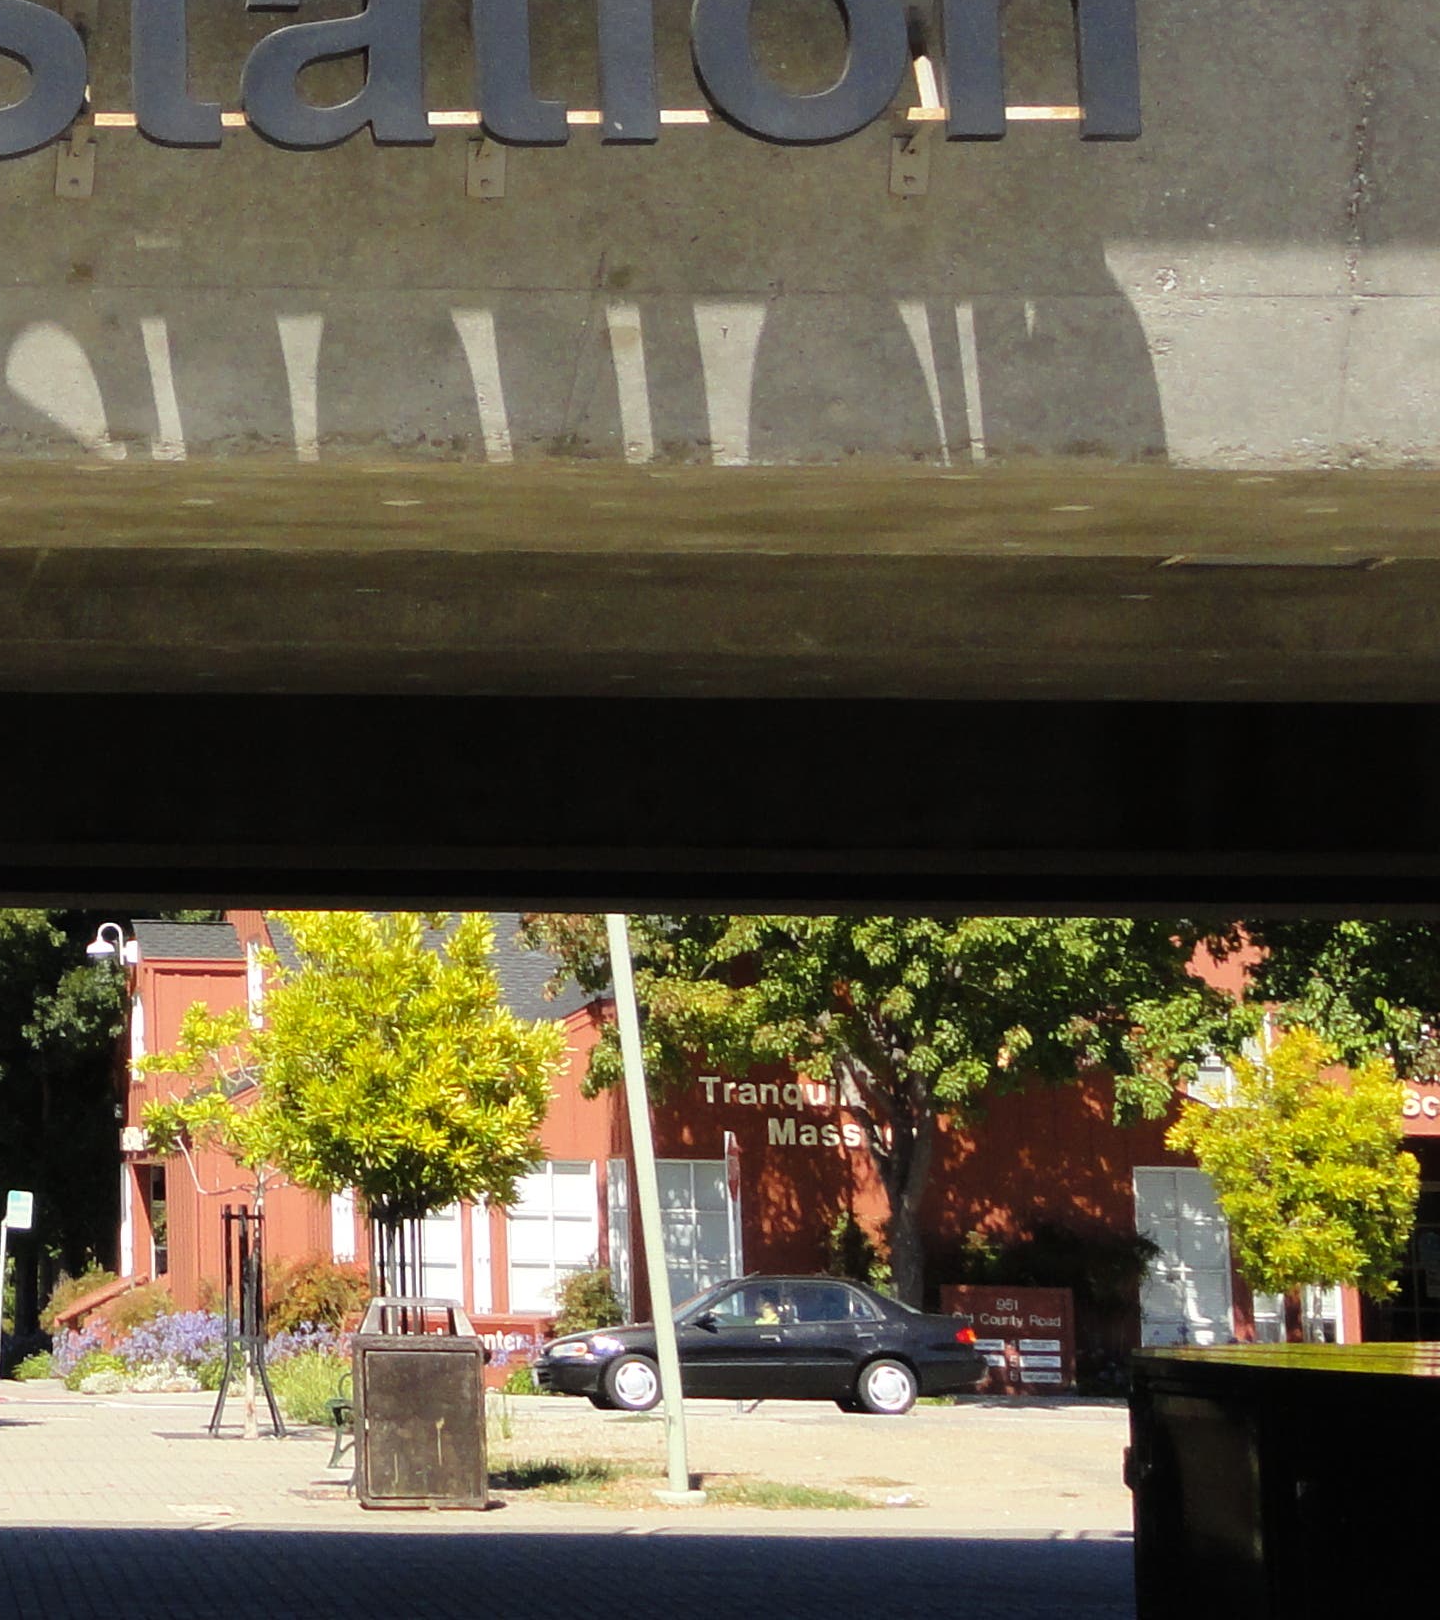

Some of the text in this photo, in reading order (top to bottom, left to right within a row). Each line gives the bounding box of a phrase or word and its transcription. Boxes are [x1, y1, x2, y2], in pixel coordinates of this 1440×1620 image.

[699, 1076, 849, 1111] Tranqui
[980, 1313, 1023, 1328] County
[1029, 1314, 1061, 1327] Road
